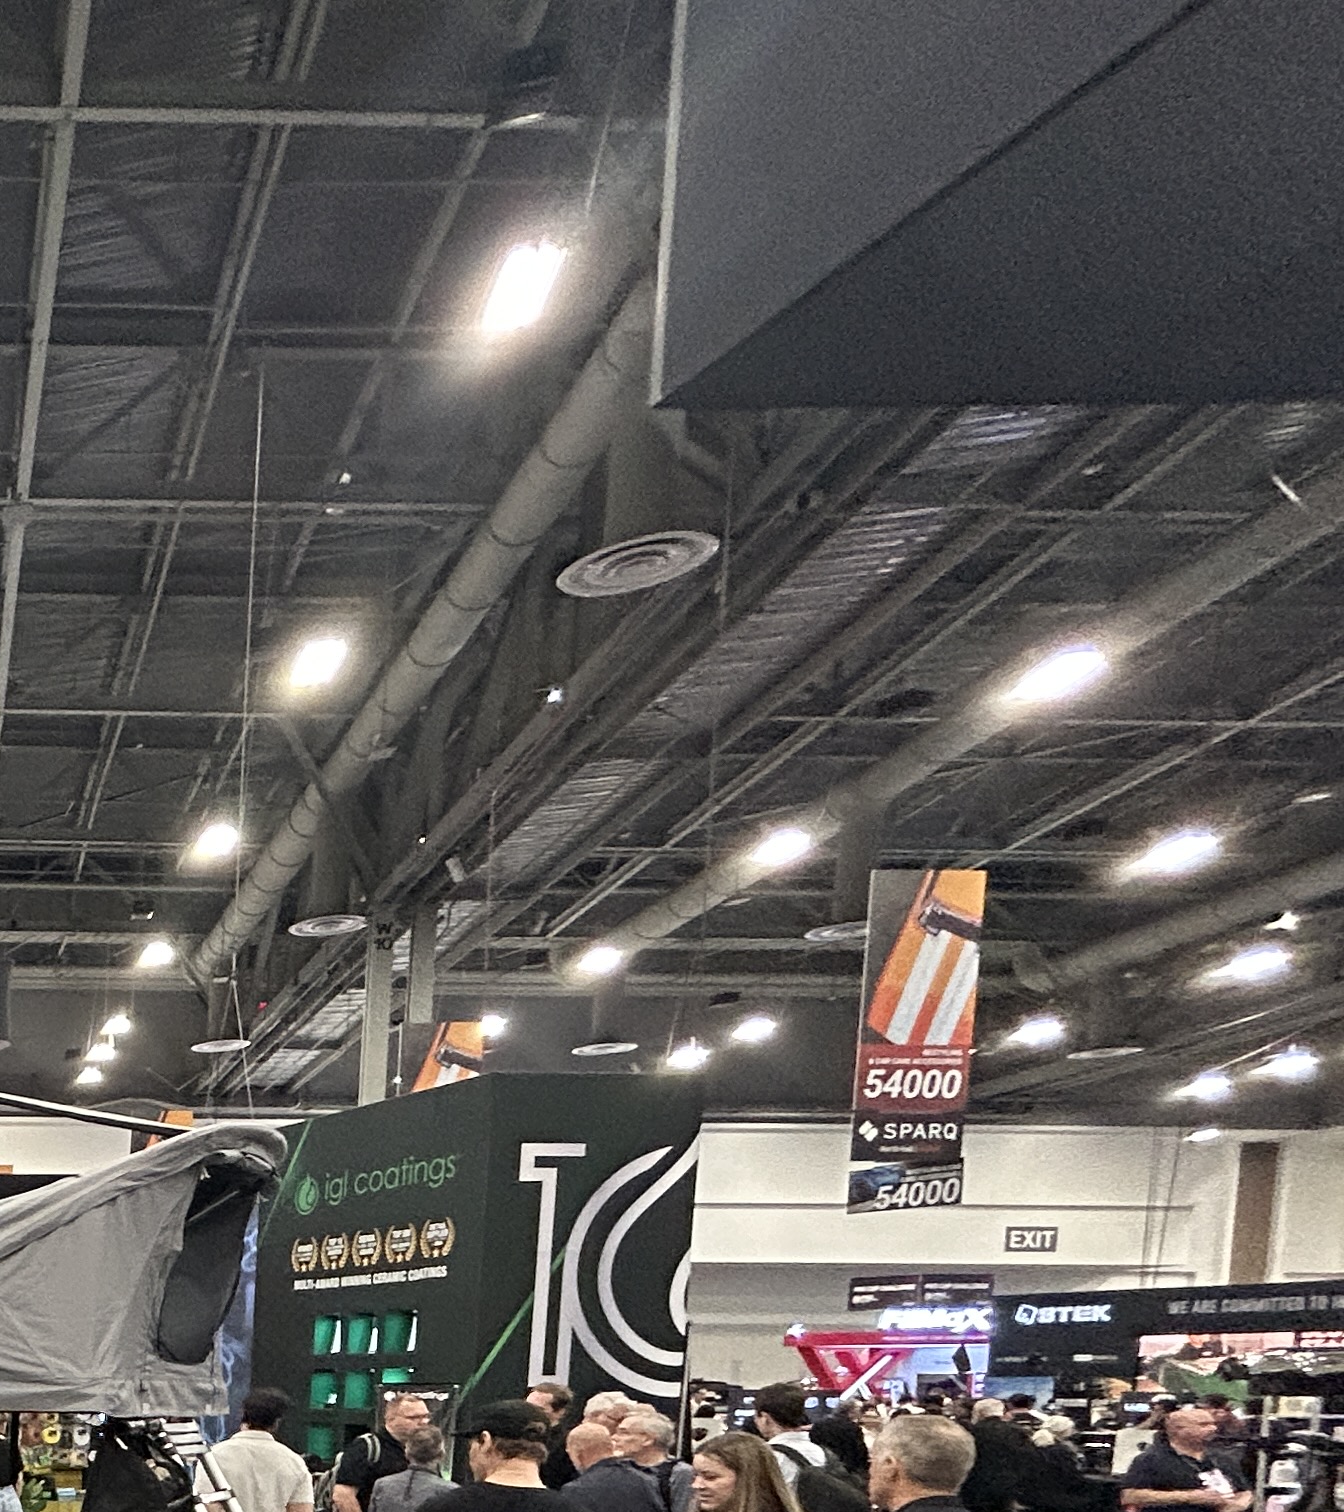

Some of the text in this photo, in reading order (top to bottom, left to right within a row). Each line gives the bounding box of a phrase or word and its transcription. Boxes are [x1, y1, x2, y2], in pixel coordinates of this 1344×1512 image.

[863, 1069, 962, 1099] 54000
[883, 1123, 959, 1141] SPARQ
[324, 1155, 457, 1206] igl coatings
[874, 1177, 961, 1210] 54000
[1009, 1230, 1055, 1248] EXIT
